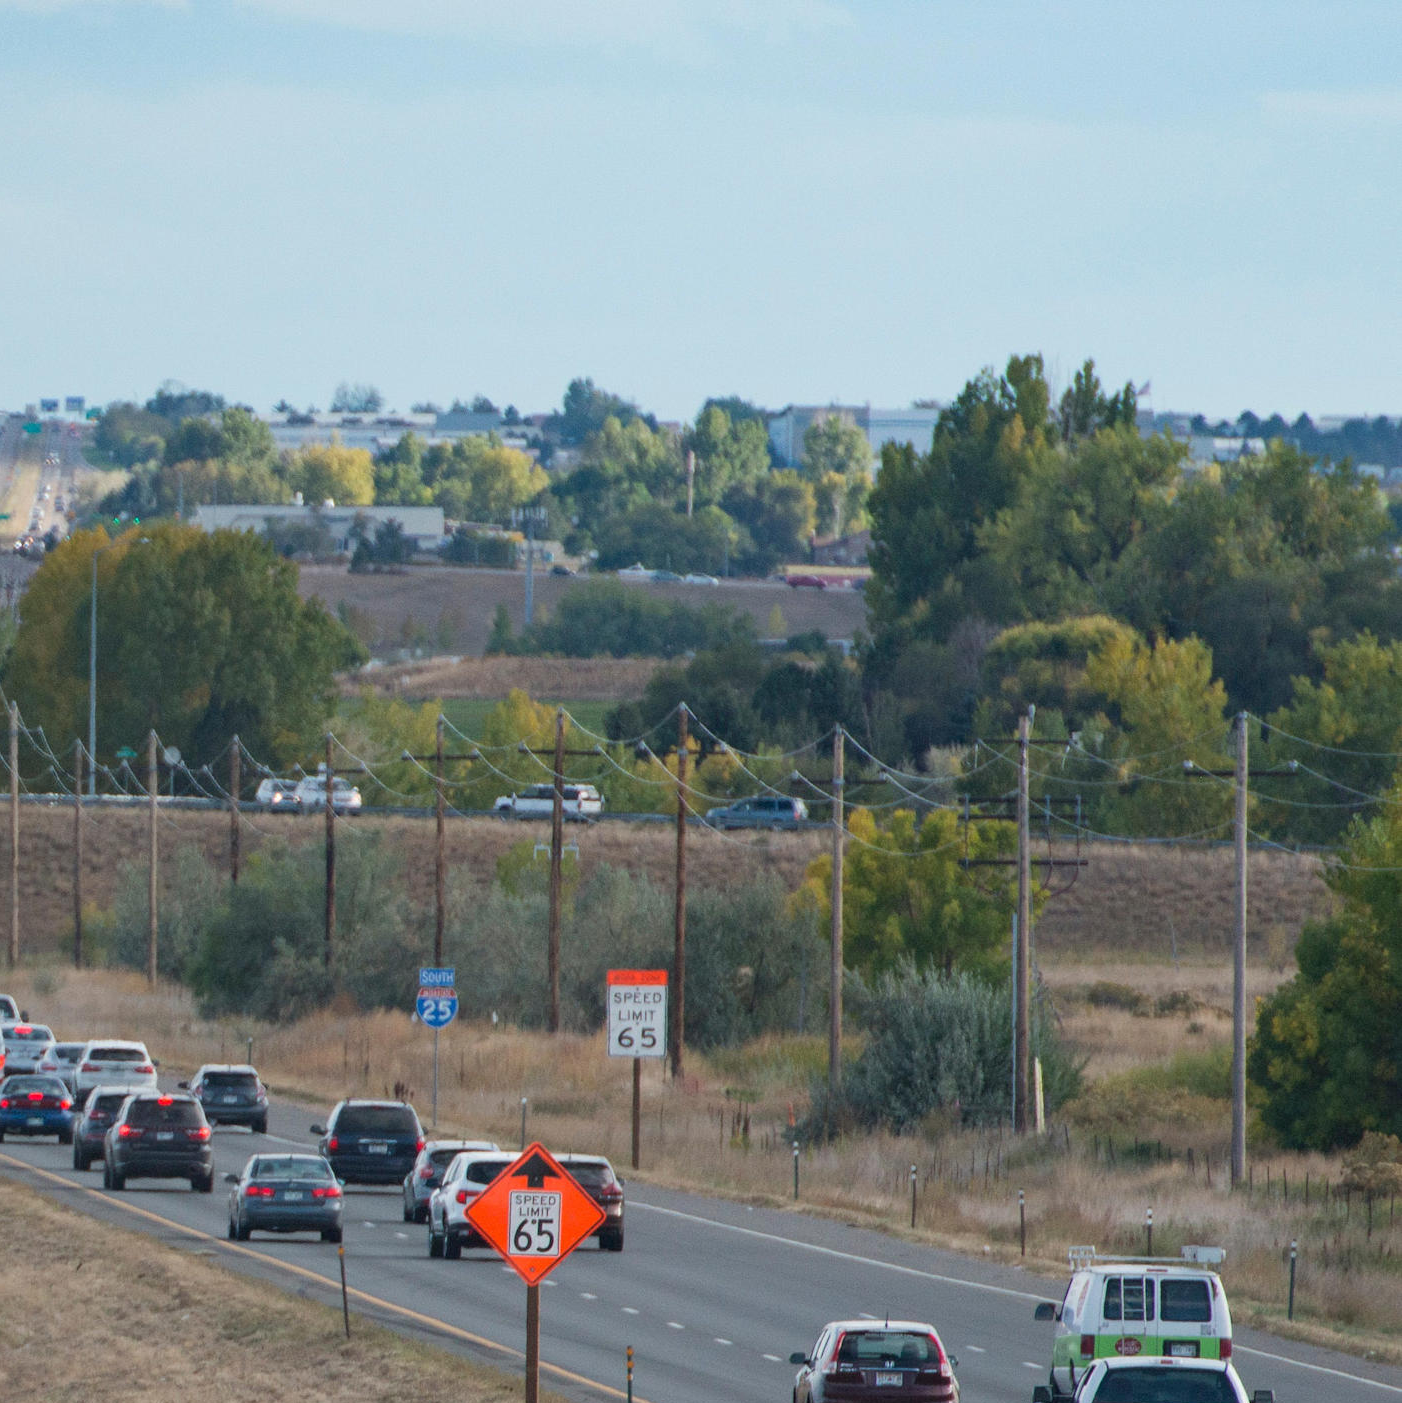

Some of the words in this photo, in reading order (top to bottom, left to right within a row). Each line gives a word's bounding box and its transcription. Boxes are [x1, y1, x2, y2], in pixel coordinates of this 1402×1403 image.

[422, 970, 454, 983] SOUTH
[614, 992, 662, 1004] SPEED
[423, 1000, 452, 1020] 25
[618, 1010, 656, 1021] LIMIT
[618, 1027, 656, 1048] 65
[515, 1194, 556, 1206] SPEED
[519, 1207, 551, 1217] LIMIT
[514, 1218, 554, 1252] 65
